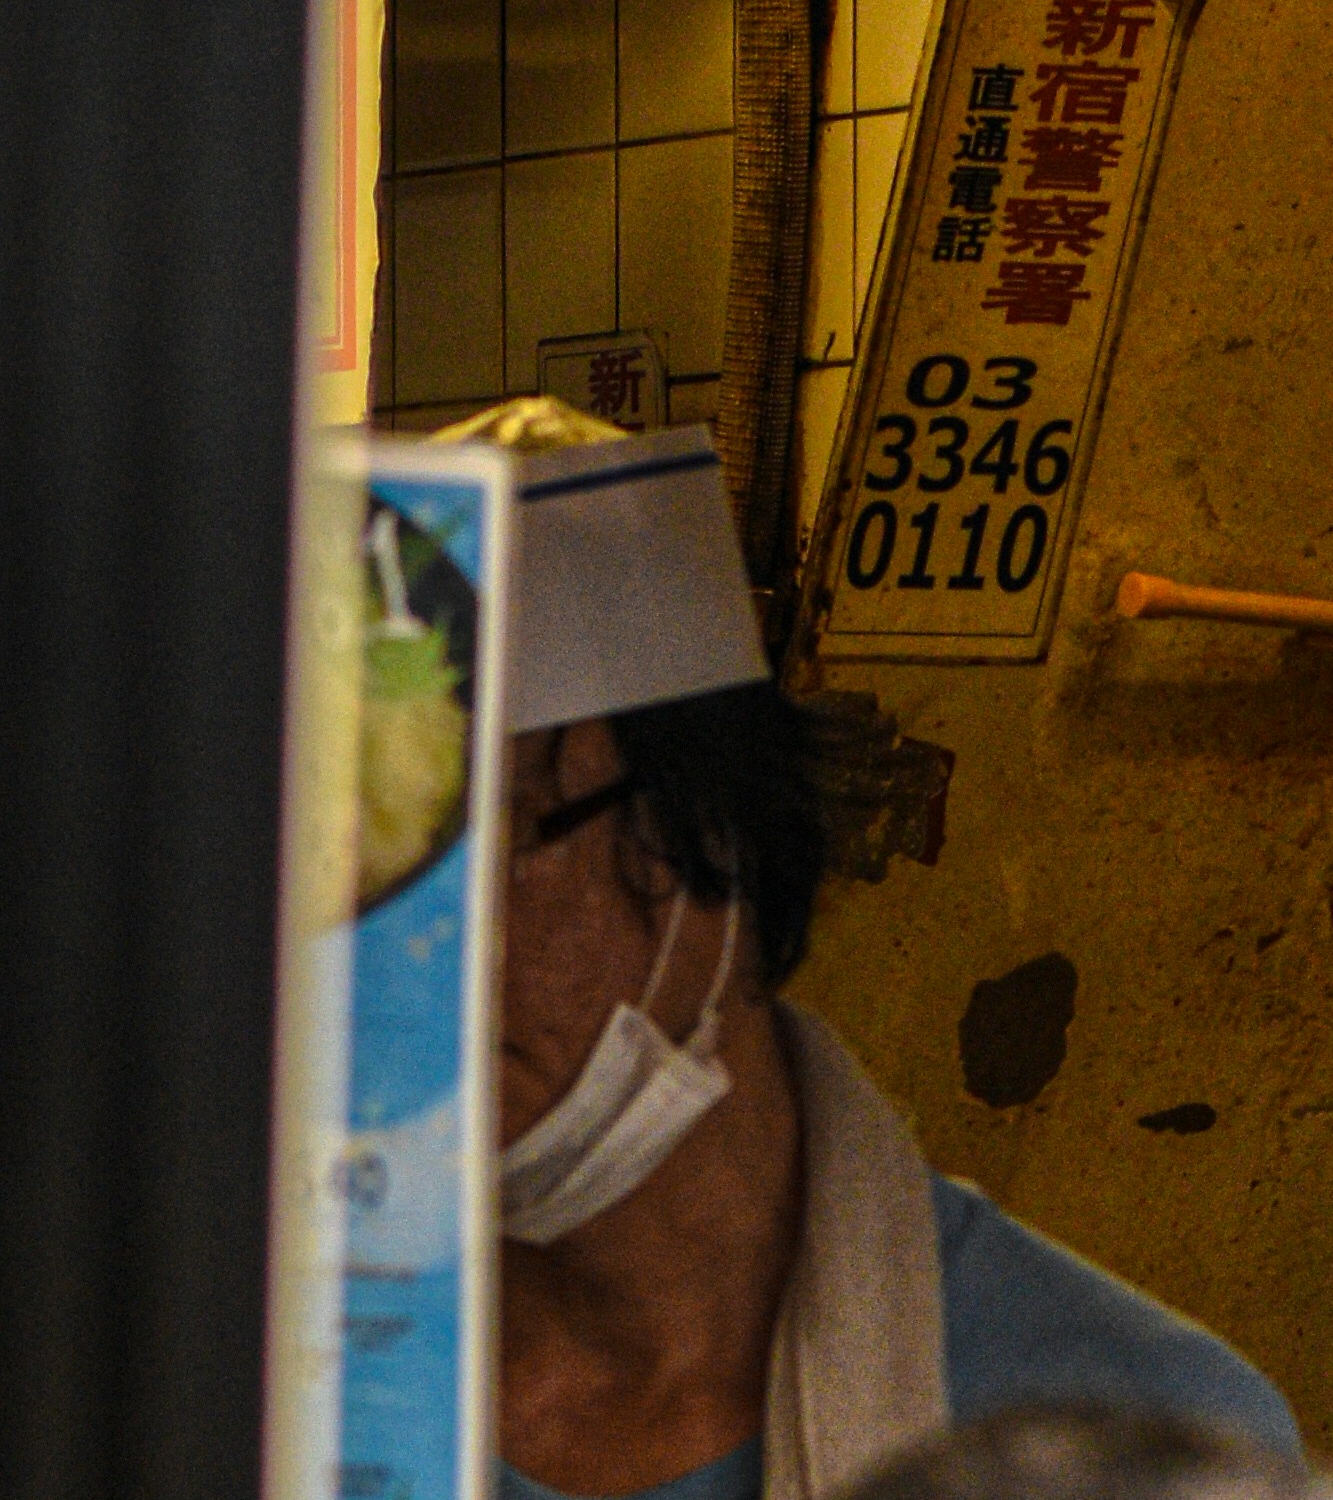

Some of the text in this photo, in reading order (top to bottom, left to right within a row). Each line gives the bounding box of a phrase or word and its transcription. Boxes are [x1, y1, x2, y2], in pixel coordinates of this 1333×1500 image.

[932, 62, 1026, 265] 直通電話
[903, 354, 1038, 411] 03
[865, 414, 1075, 498] 3346
[846, 502, 1049, 594] 0110
